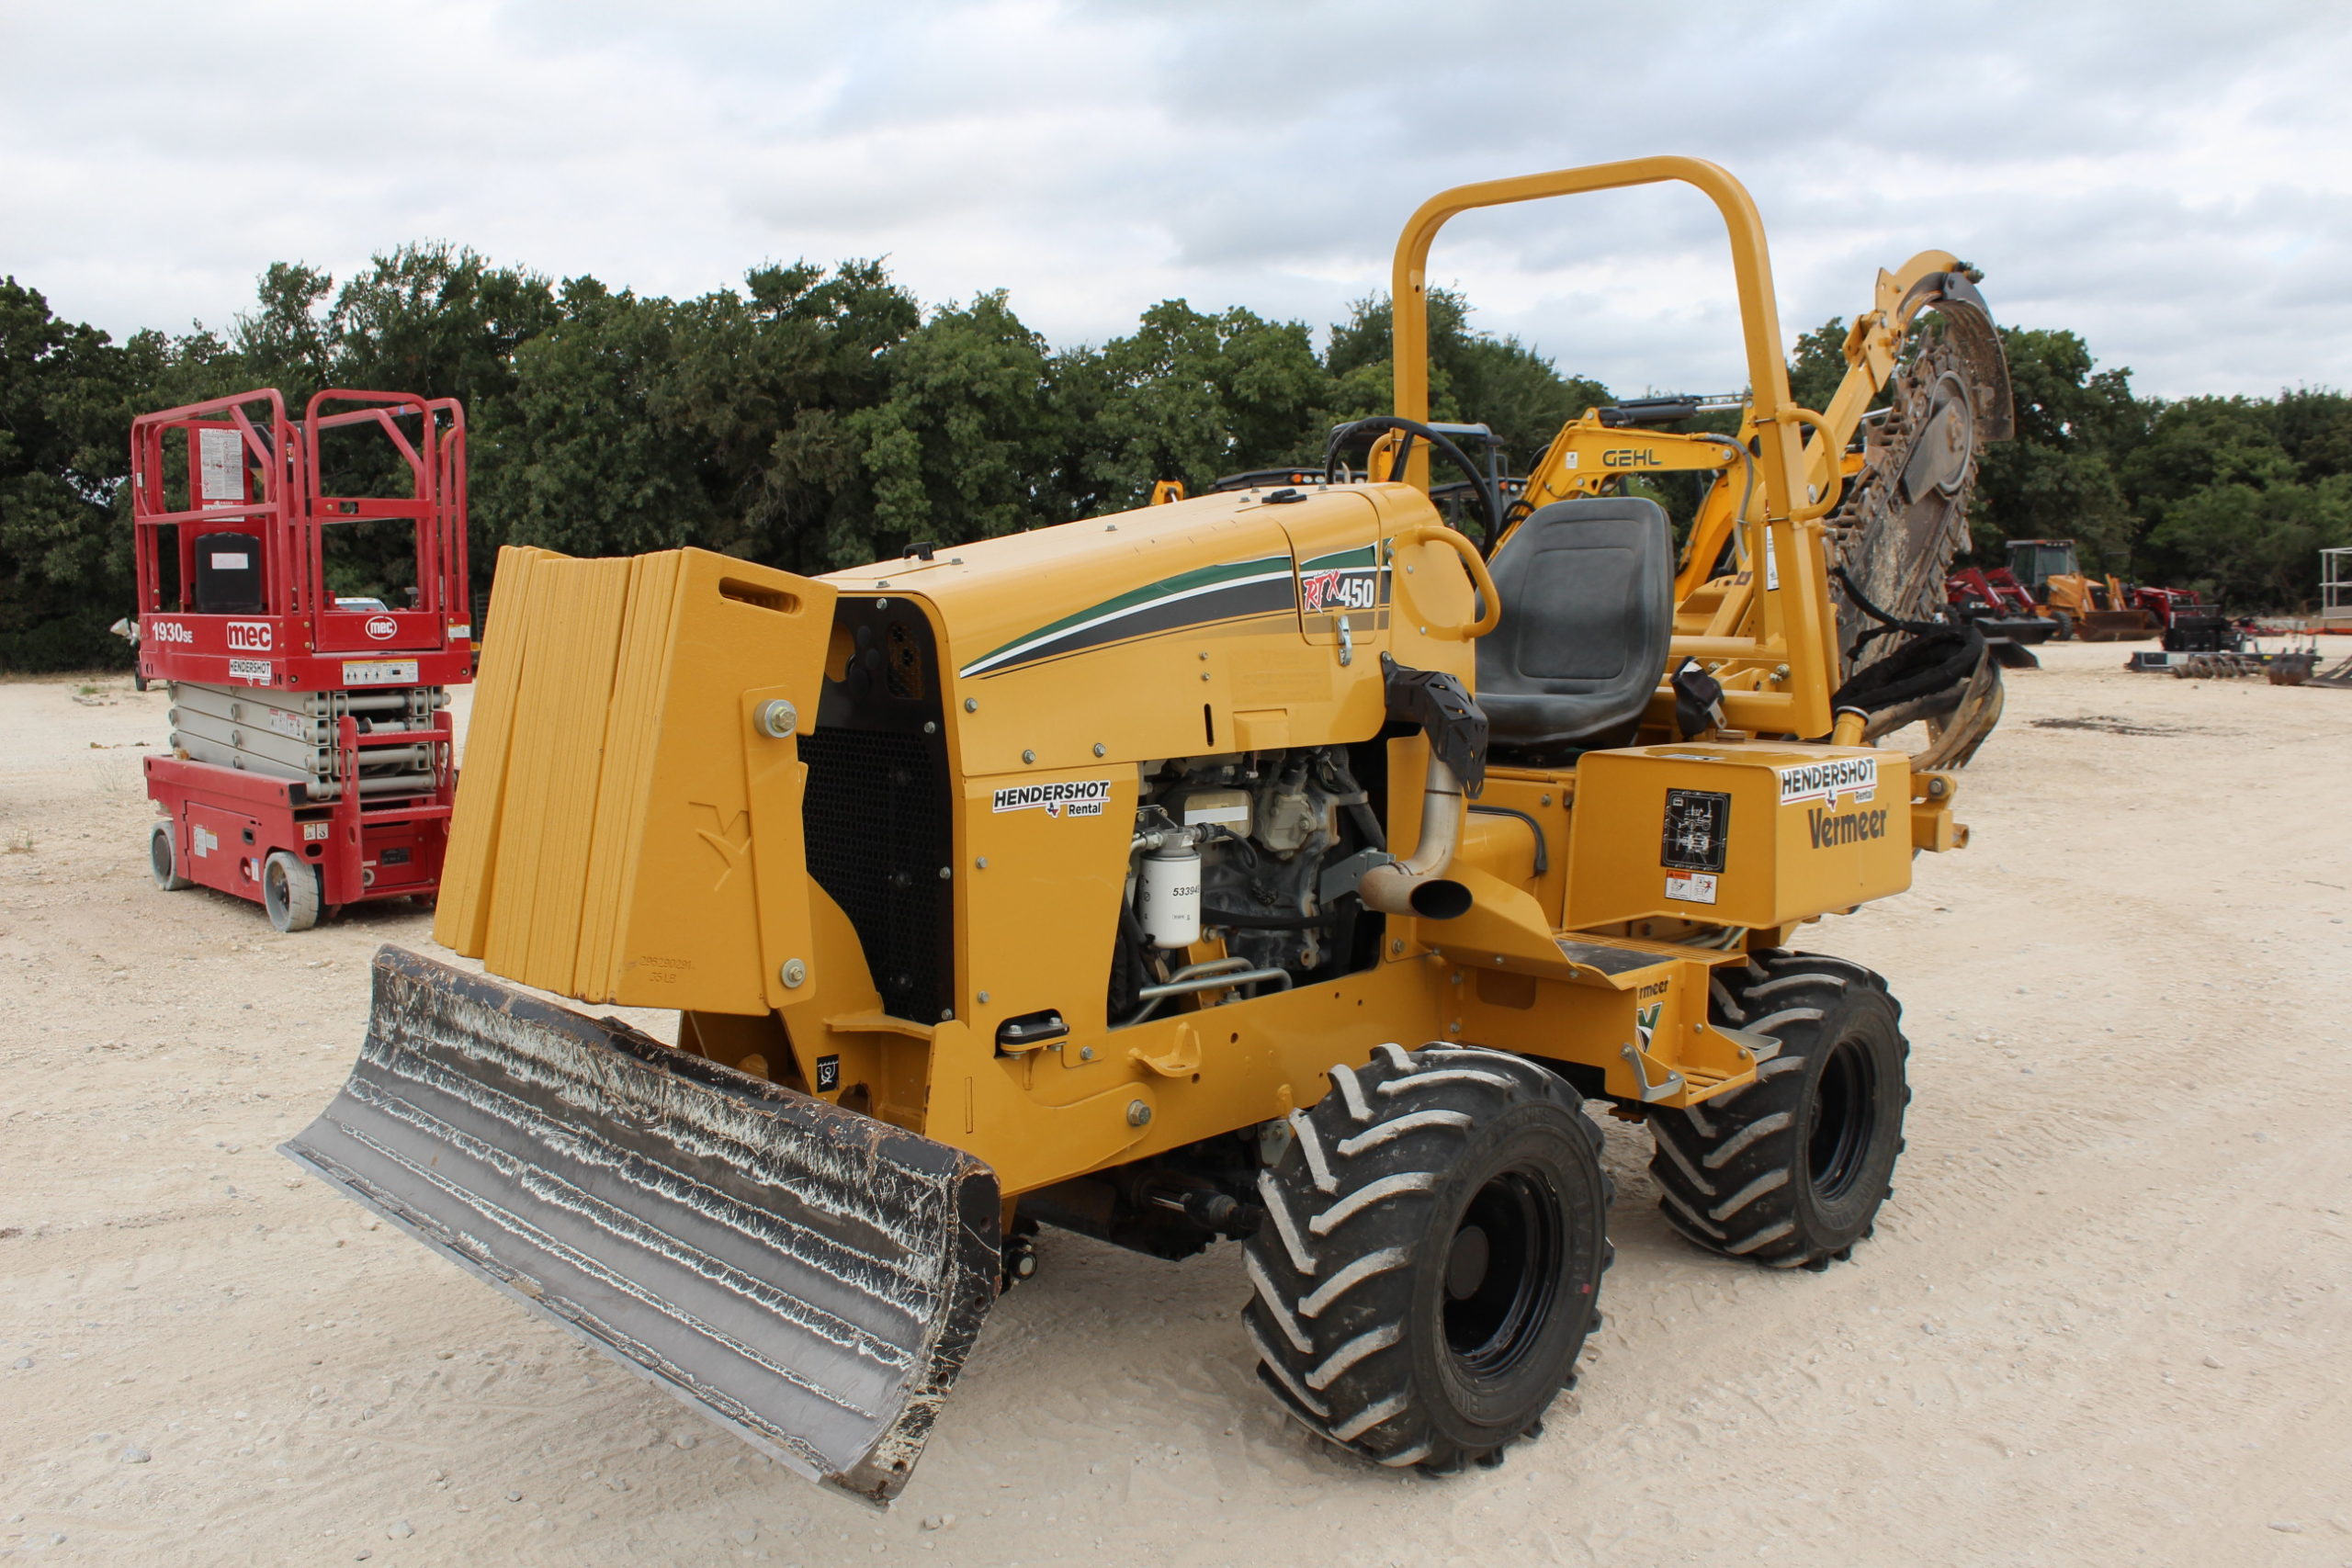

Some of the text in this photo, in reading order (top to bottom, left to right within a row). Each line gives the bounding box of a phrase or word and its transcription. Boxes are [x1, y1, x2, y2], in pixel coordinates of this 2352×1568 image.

[1602, 448, 1662, 467] GEHL
[1303, 569, 1374, 613] RTX 450
[228, 625, 271, 648] mec
[230, 660, 270, 675] HENDERSHOT
[1781, 759, 1874, 795] HENDERSHOT
[994, 782, 1109, 807] HENDERSHOT
[1069, 802, 1101, 815] Rental
[1808, 807, 1887, 850] Vermeer
[1639, 979, 1668, 1000] rmeer
